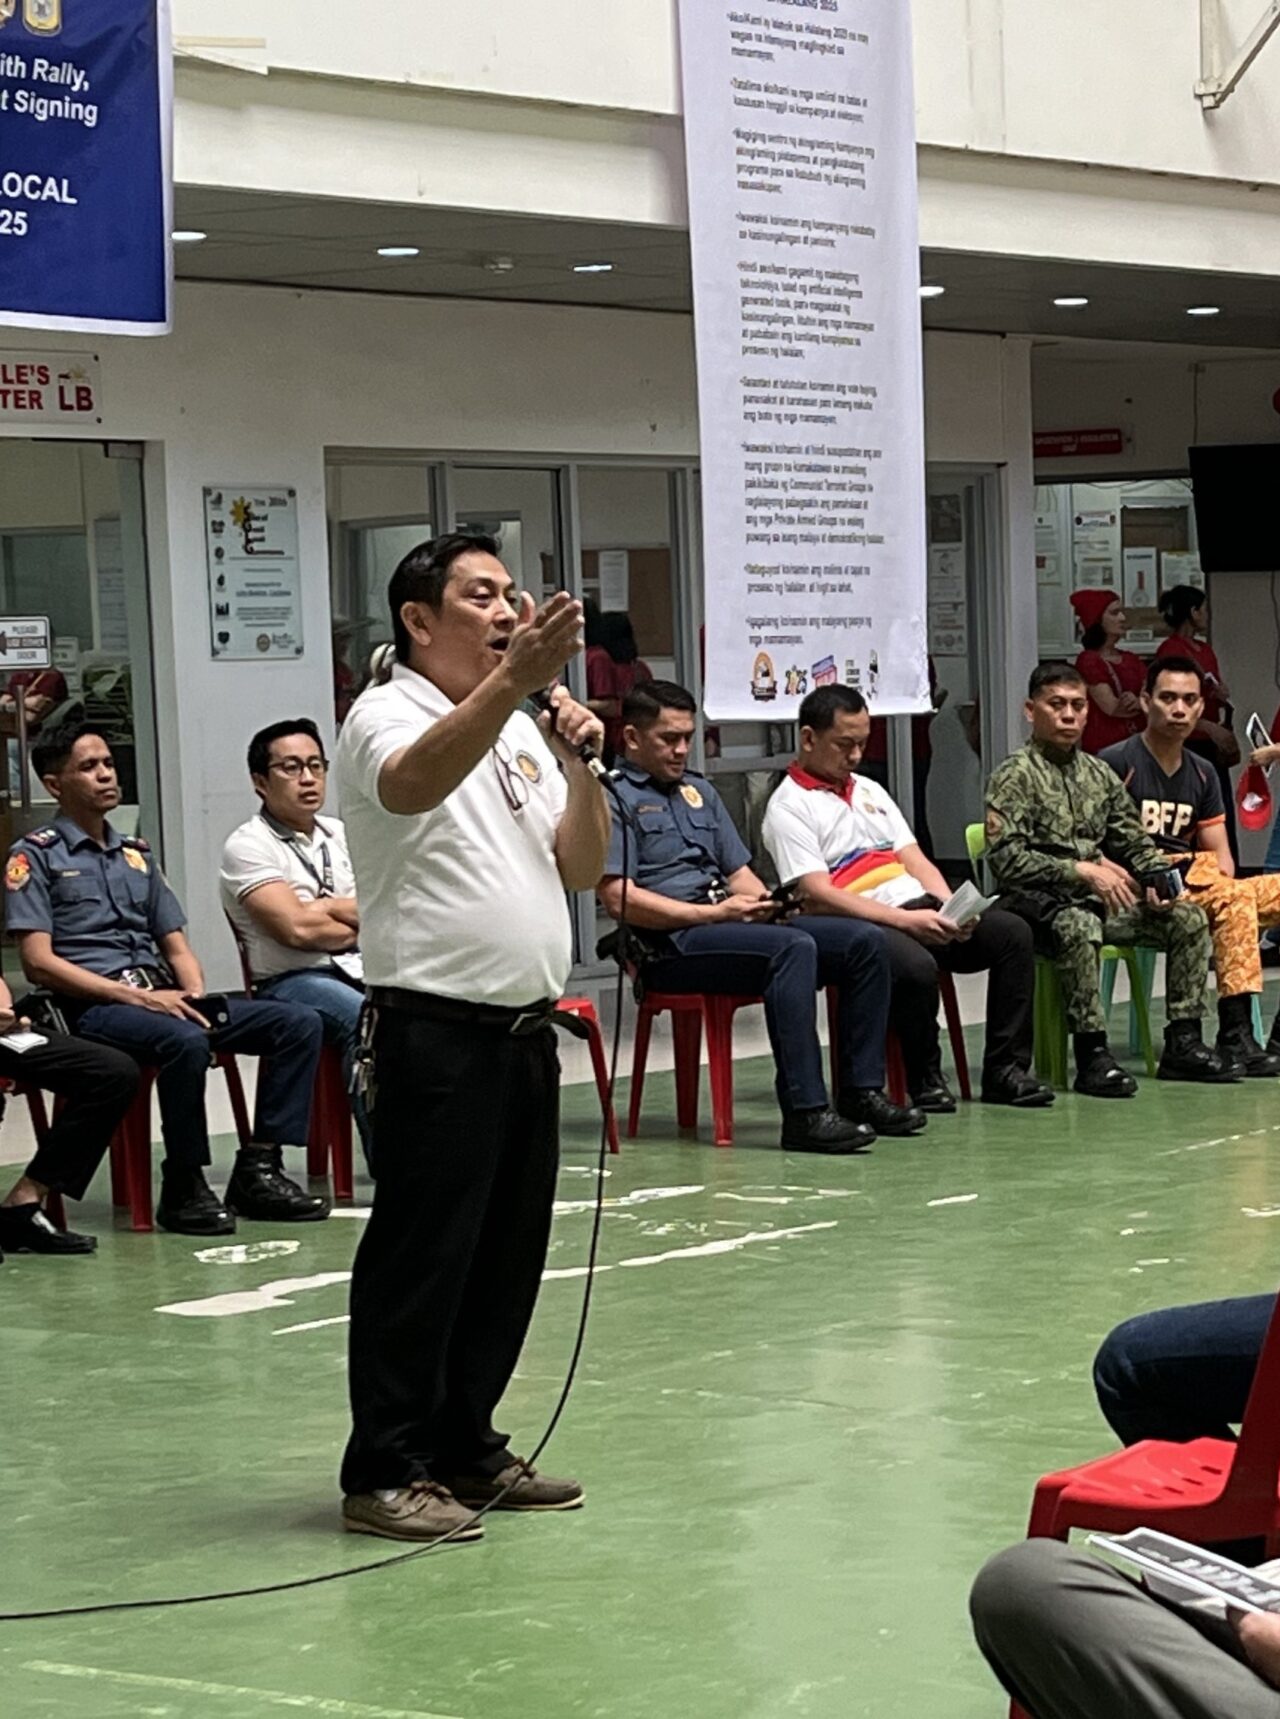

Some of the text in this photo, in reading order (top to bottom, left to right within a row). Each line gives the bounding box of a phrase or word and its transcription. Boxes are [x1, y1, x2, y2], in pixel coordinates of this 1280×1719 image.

[32, 58, 89, 92] Rally,
[14, 89, 98, 127] Signing
[0, 171, 77, 204] OCAL
[58, 385, 93, 411] LB
[1141, 799, 1193, 837] BFP
